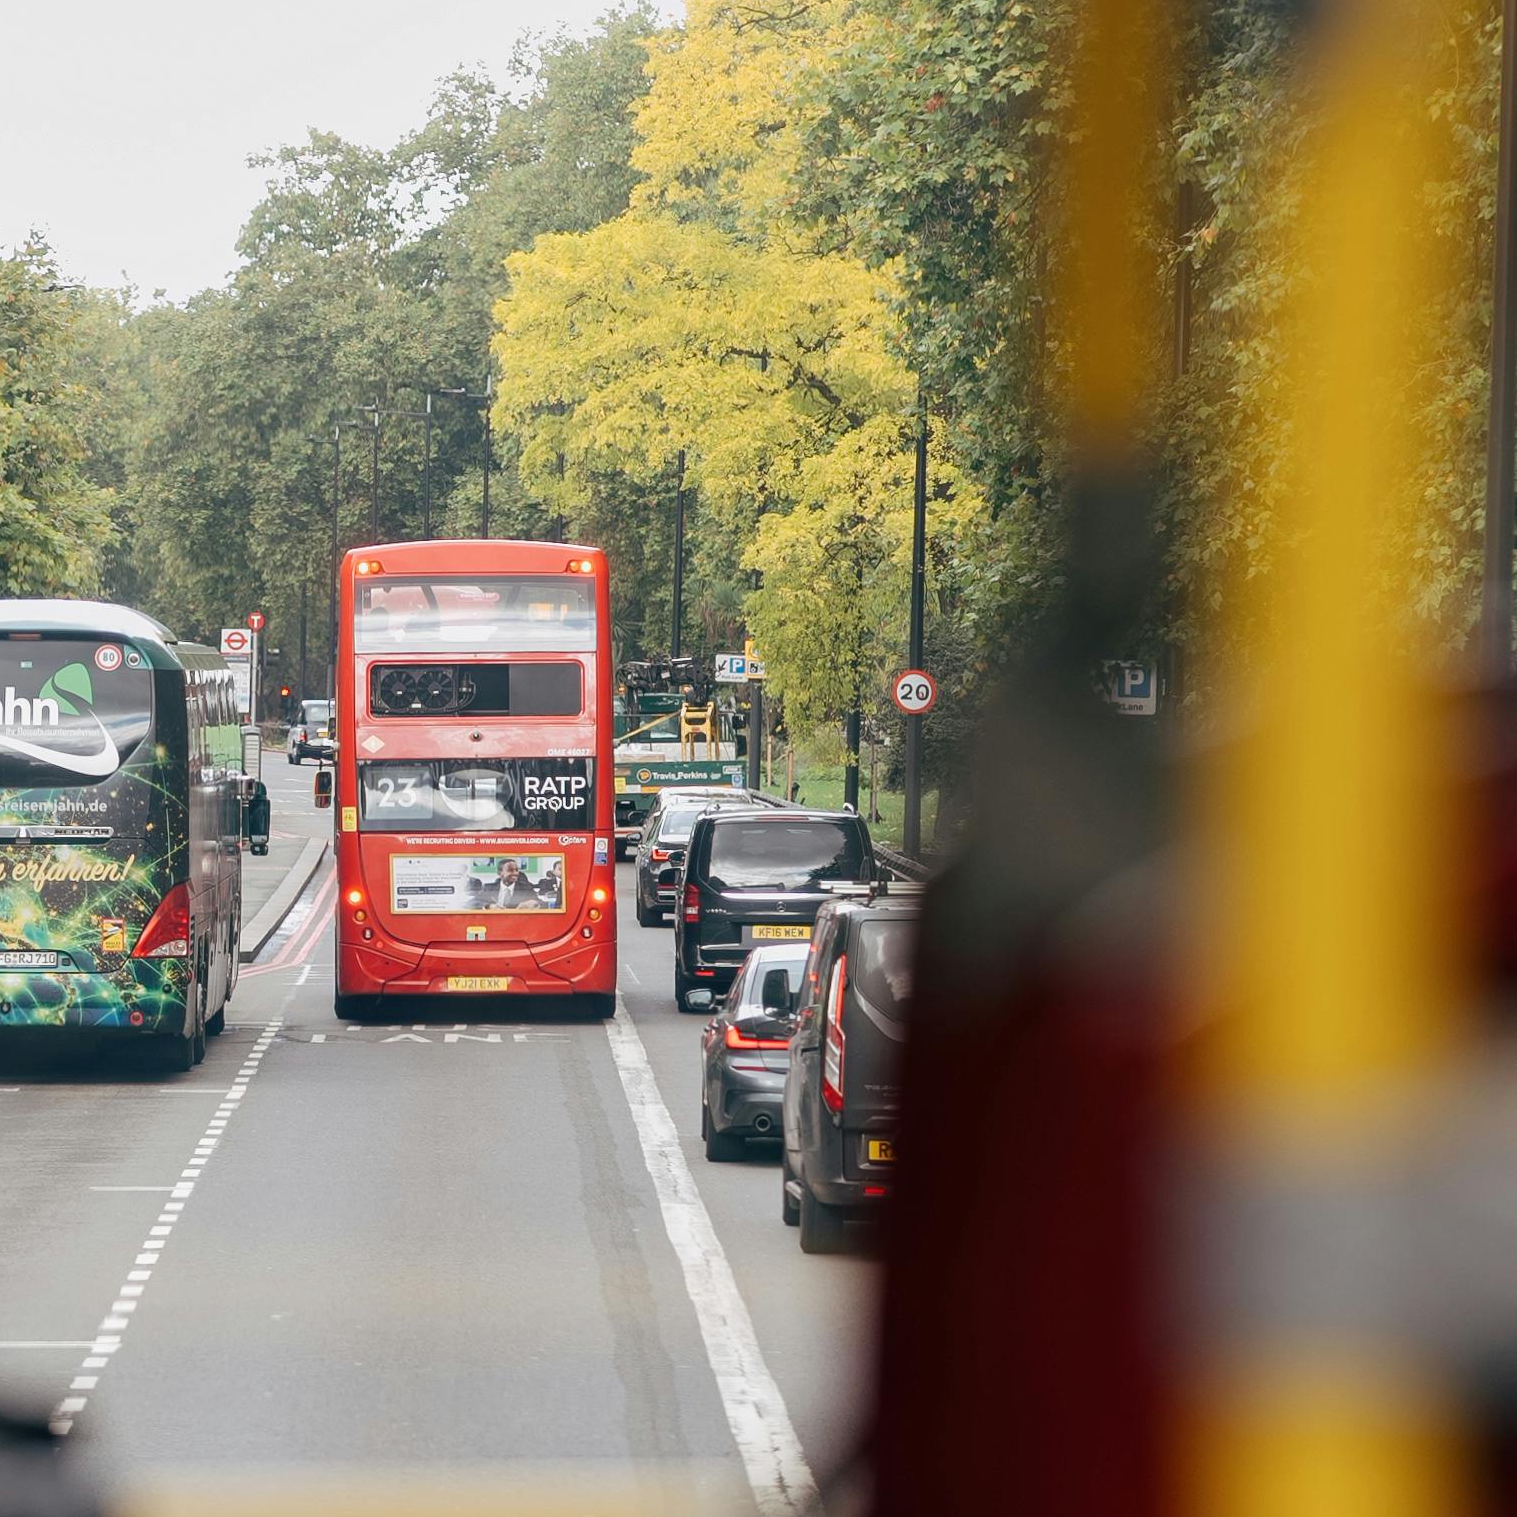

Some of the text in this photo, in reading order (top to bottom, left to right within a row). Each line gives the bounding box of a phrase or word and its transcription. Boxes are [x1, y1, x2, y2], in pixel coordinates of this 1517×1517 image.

[103, 653, 114, 663] 80
[732, 658, 743, 673] P
[900, 683, 930, 701] 20
[652, 771, 708, 780] Travis Perkins
[377, 777, 417, 808] 23
[524, 776, 586, 795] RATP
[524, 796, 585, 812] GROUP
[11, 854, 135, 893] erfahren!
[759, 928, 782, 937] KF16
[36, 953, 56, 964] 710
[453, 978, 500, 989] YJ21 EXK
